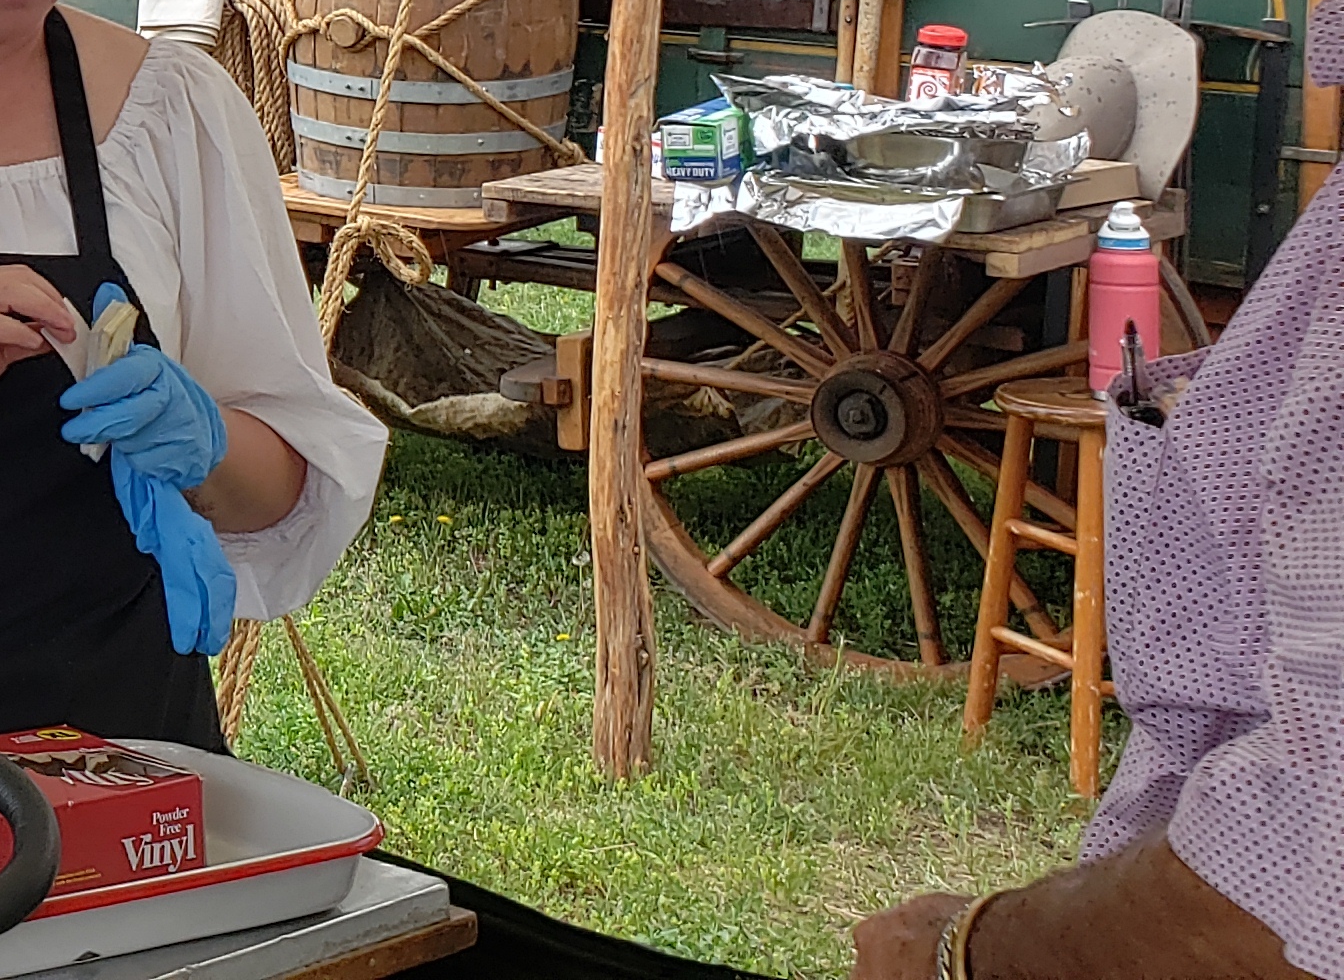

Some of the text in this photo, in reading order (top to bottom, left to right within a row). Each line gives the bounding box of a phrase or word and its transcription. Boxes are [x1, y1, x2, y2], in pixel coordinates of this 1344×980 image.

[666, 167, 715, 177] HEAVY DUTY
[152, 807, 190, 826] Powder
[159, 822, 182, 837] Free
[121, 824, 197, 873] Vinyl
